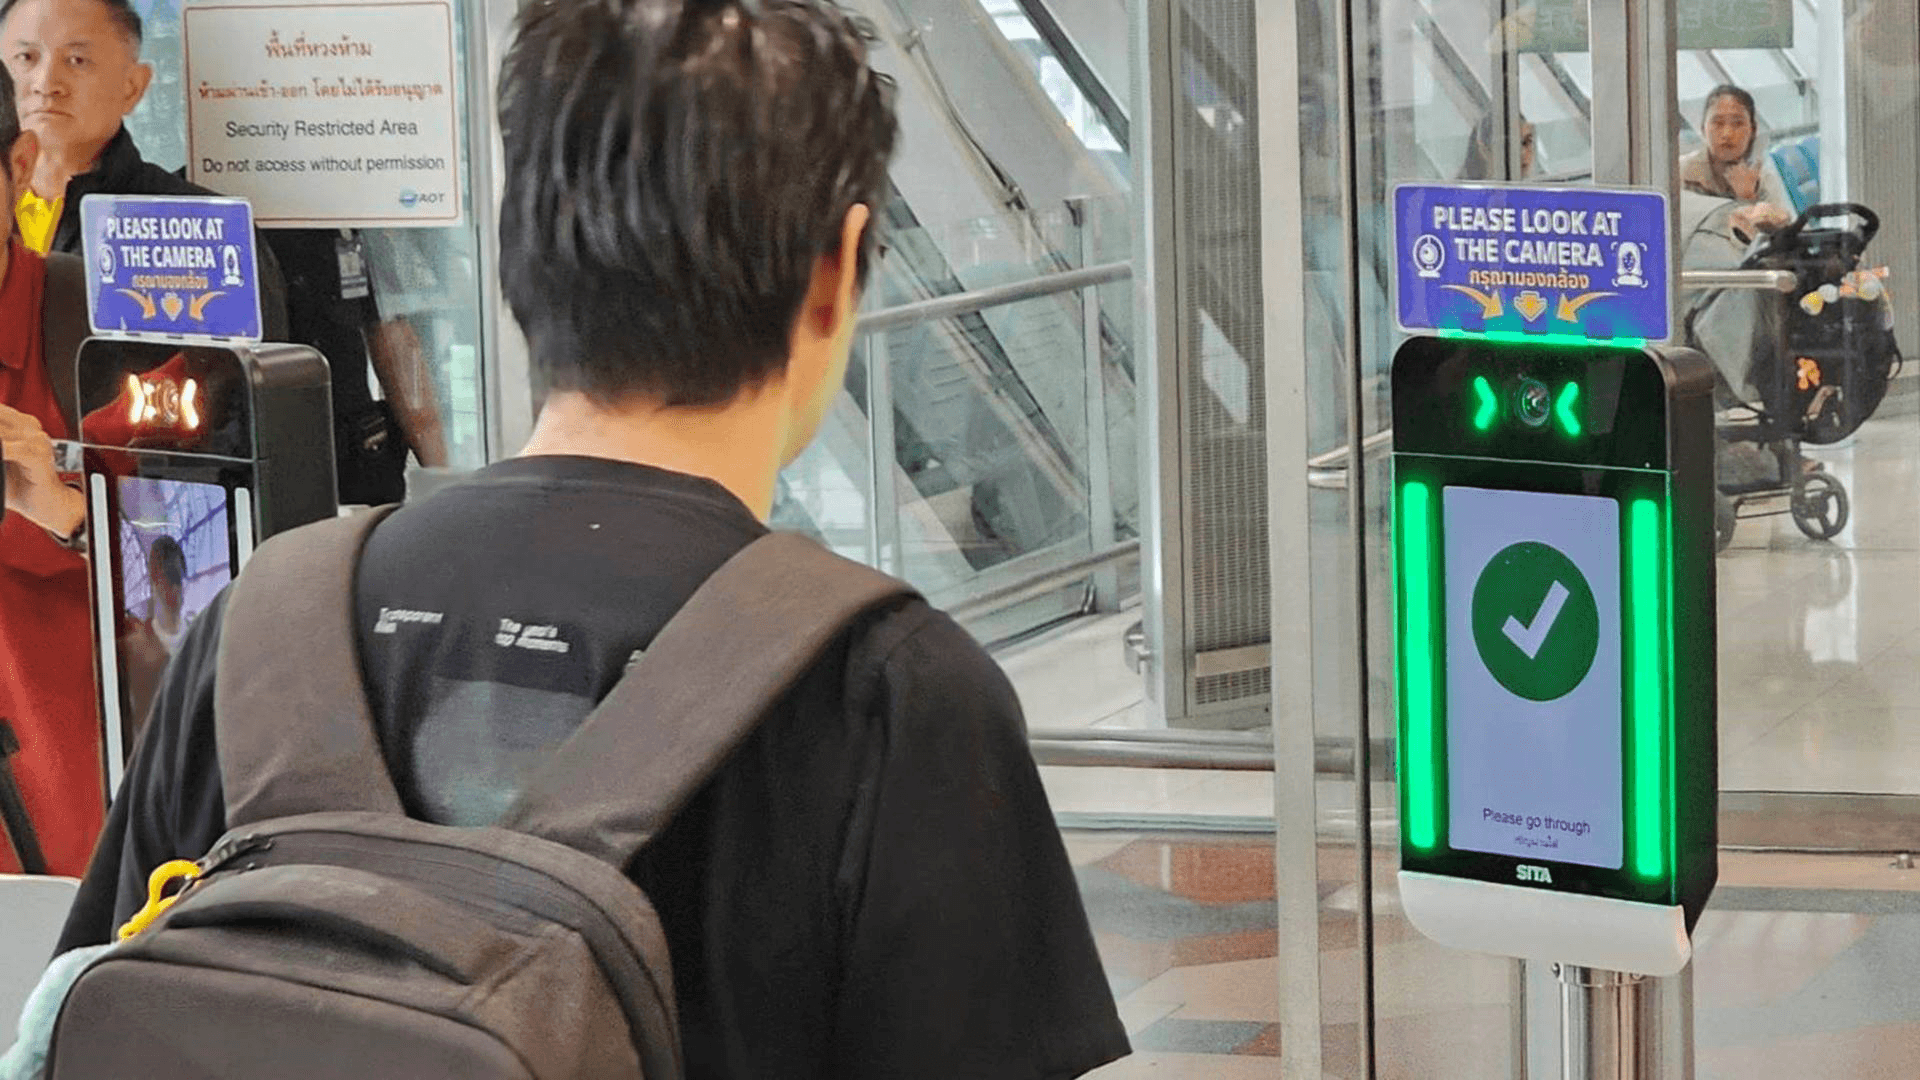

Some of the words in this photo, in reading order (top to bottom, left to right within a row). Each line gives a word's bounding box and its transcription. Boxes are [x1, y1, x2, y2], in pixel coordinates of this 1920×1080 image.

[225, 121, 289, 141] Security
[295, 120, 375, 136] Restricted
[380, 120, 418, 135] Area
[203, 158, 222, 173] Do
[227, 159, 251, 172] not
[255, 159, 306, 172] access
[310, 157, 363, 172] without
[366, 156, 445, 174] permission
[107, 217, 159, 239] PLEASE
[161, 218, 203, 240] LOOK
[206, 219, 224, 240] AT
[1434, 206, 1516, 232] PLEASE
[1522, 208, 1588, 235] LOOK
[1592, 212, 1621, 236] AT
[120, 246, 151, 267] THE
[153, 246, 216, 269] CAMERA
[1454, 238, 1499, 262] THE
[1504, 239, 1603, 267] CAMERA
[1469, 267, 1589, 290] กรุณามองกล้อง
[1483, 808, 1522, 825] Please
[1526, 816, 1541, 830] go
[1544, 816, 1590, 836] through
[1516, 864, 1552, 883] SITA
